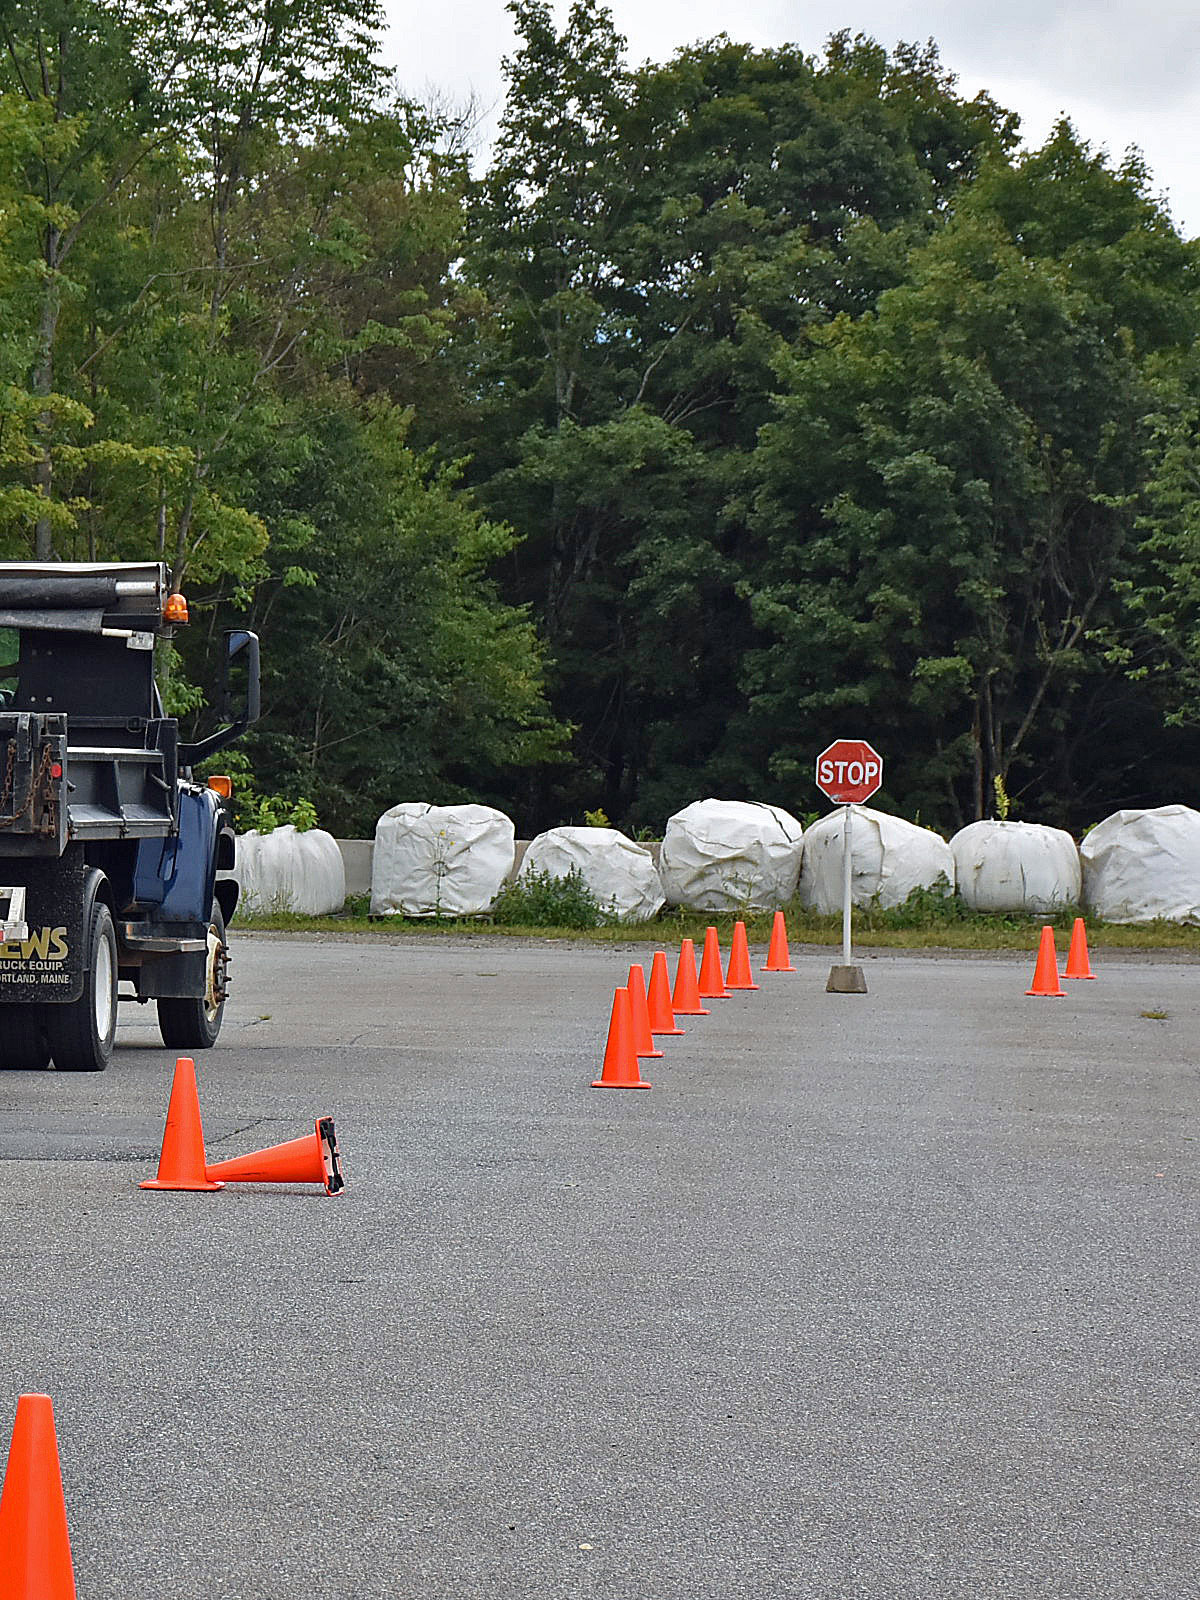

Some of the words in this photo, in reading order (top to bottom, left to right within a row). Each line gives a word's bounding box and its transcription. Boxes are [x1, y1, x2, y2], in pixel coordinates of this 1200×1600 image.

[819, 760, 880, 785] STOP
[29, 961, 65, 971] EQUIP.
[41, 974, 70, 984] MAINE
